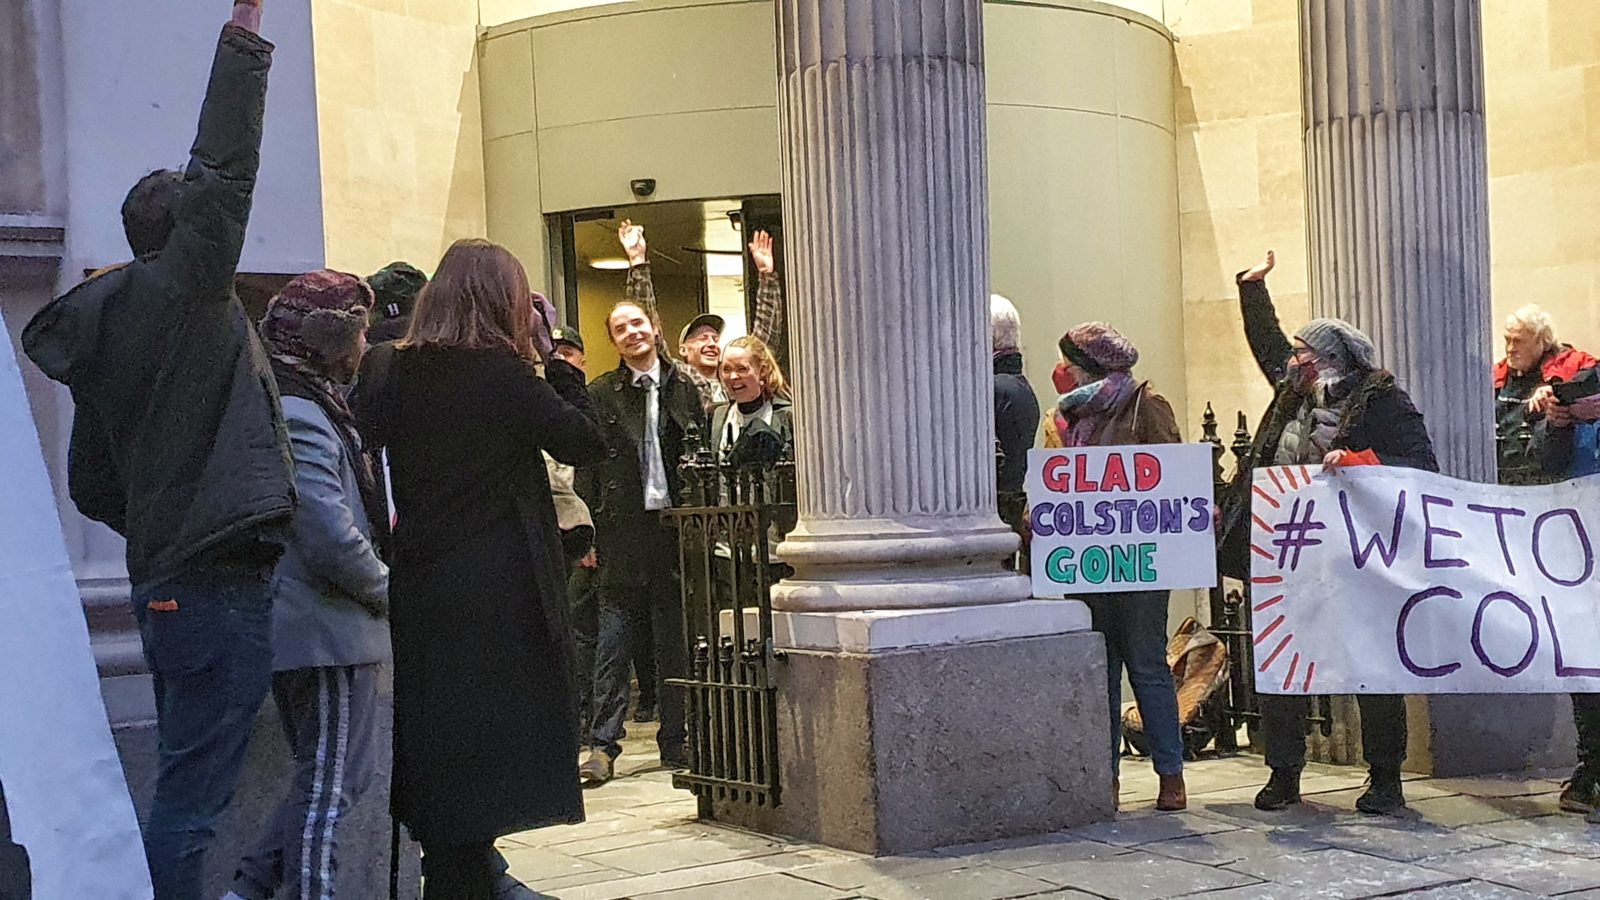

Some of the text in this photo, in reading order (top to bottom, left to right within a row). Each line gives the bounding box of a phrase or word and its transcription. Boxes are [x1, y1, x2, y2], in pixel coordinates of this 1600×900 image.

[1042, 453, 1162, 493] GLAD
[1031, 496, 1209, 536] COLSTON'S
[1045, 543, 1157, 584] GONE
